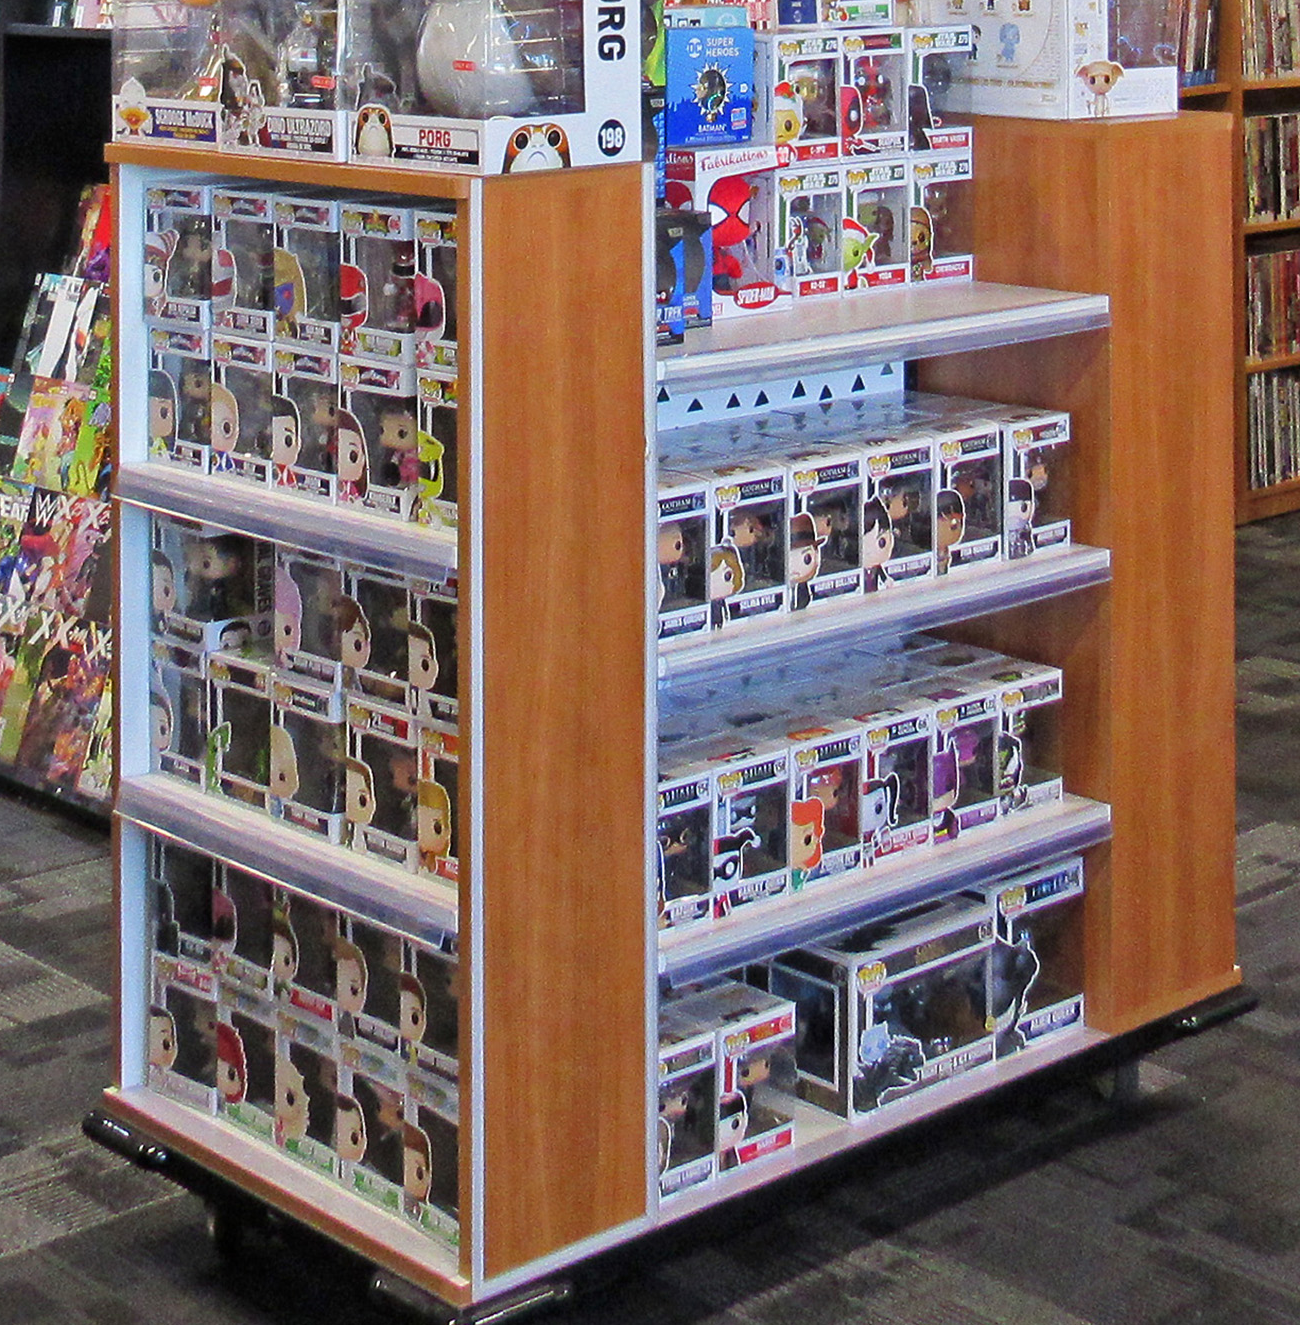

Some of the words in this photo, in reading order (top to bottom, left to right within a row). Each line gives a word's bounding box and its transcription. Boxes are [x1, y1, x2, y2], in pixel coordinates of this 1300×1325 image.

[706, 38, 734, 47] SUPER
[706, 48, 739, 58] HEROES
[419, 130, 451, 147] PORG
[600, 128, 622, 148] 198
[700, 150, 769, 172] Fabrikations
